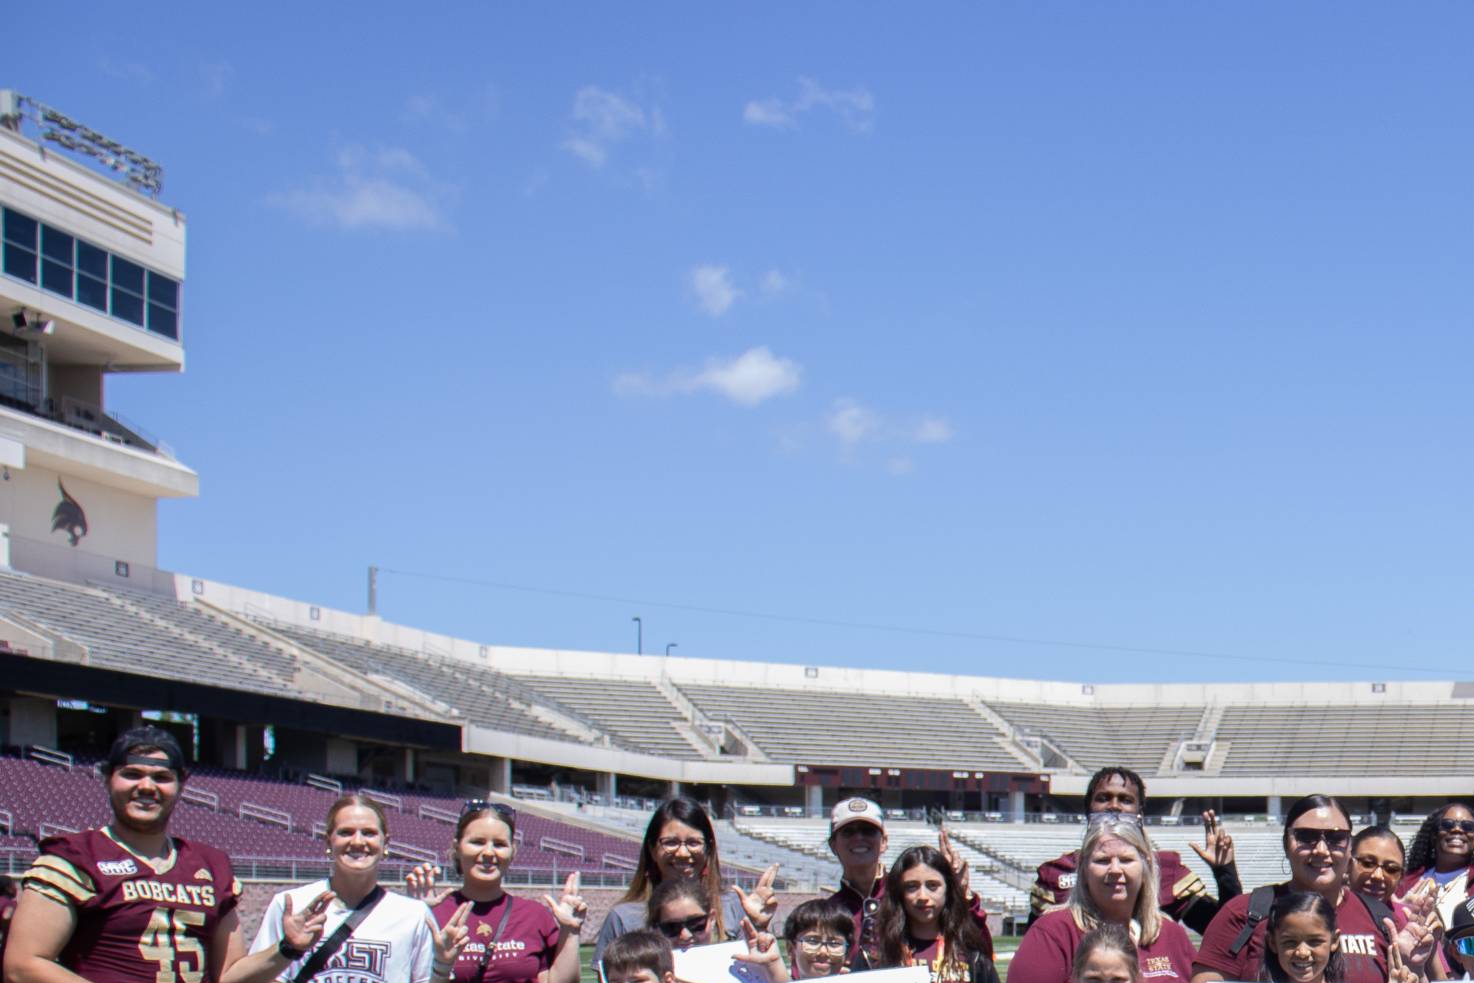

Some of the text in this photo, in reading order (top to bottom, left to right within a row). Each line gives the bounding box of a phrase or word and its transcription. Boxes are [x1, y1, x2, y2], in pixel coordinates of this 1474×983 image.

[123, 880, 216, 907] BOBCATS
[491, 939, 526, 951] tate
[1340, 934, 1378, 956] TATE
